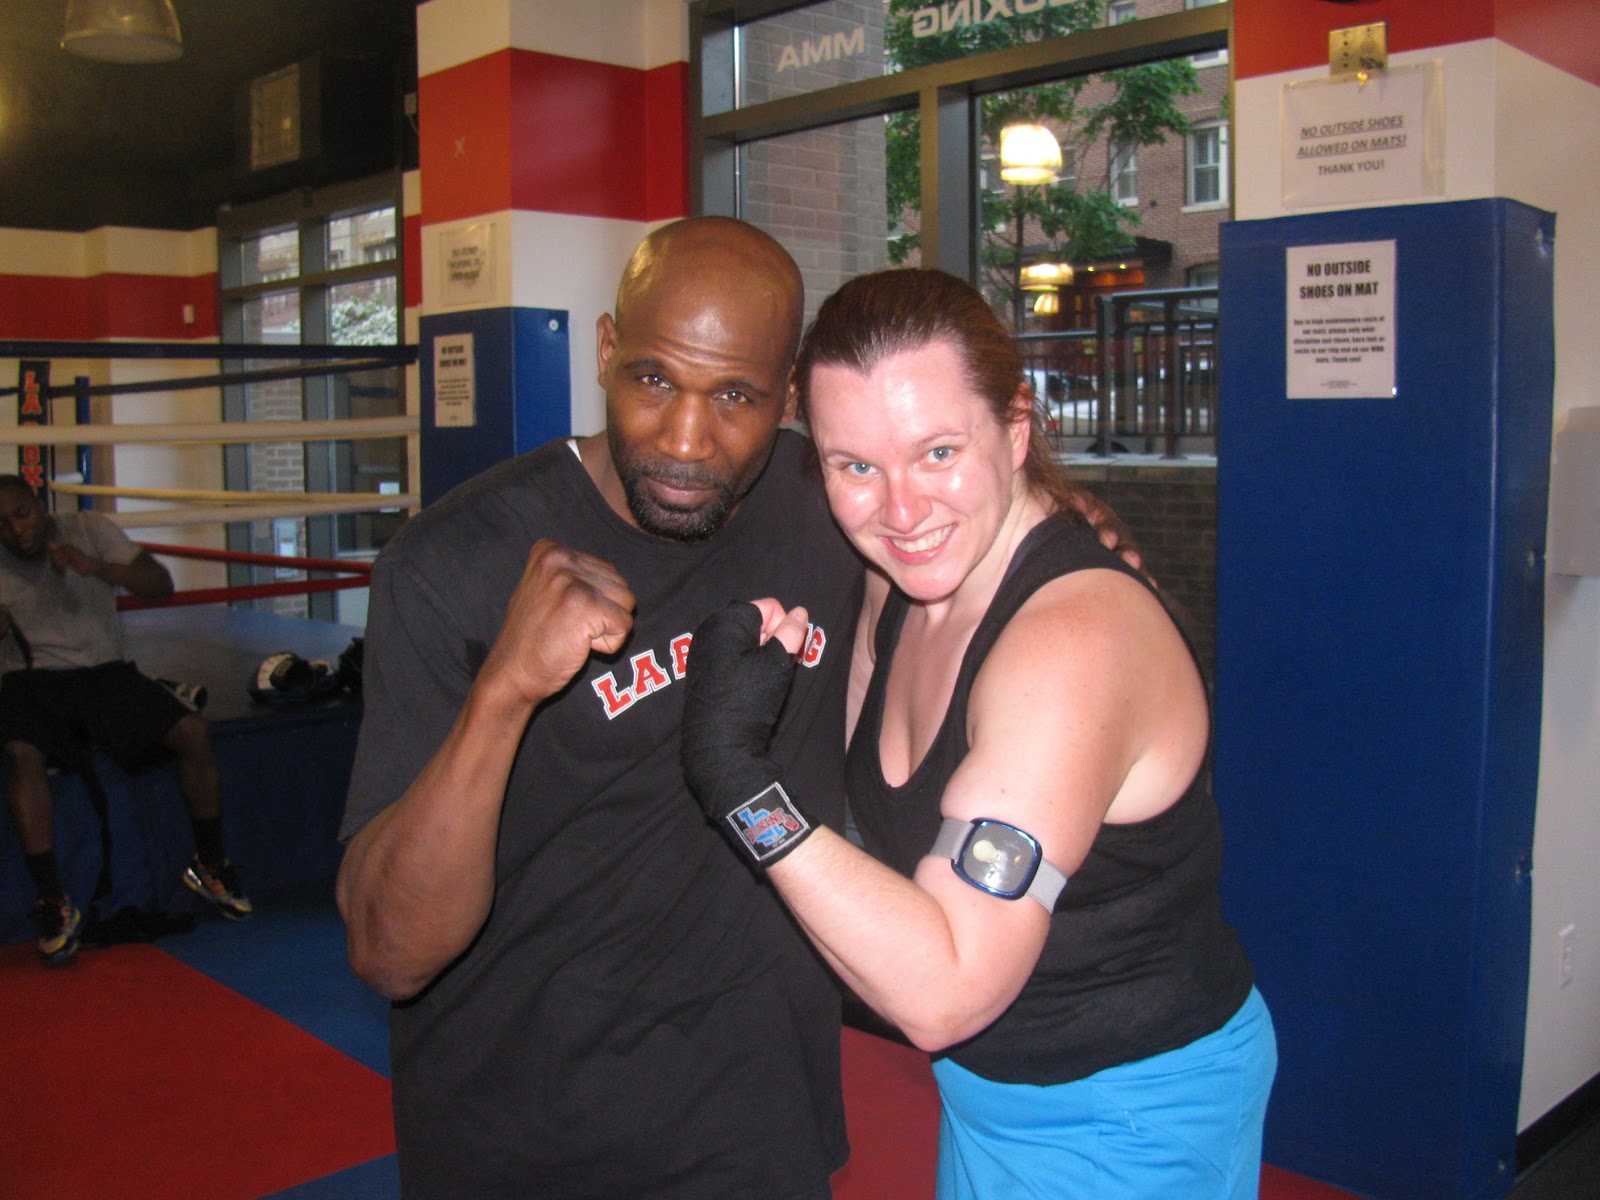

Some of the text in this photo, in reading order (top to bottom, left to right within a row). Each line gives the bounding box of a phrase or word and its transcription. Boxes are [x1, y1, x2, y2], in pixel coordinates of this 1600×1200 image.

[1301, 115, 1404, 138] NO OUTSIDE SHOES
[1297, 134, 1407, 157] ALLOWED ON MATS!
[1318, 159, 1385, 176] THANK YOU!
[1306, 260, 1371, 277] NO OUTSIDE
[1300, 281, 1379, 299] SHOES ON MAT
